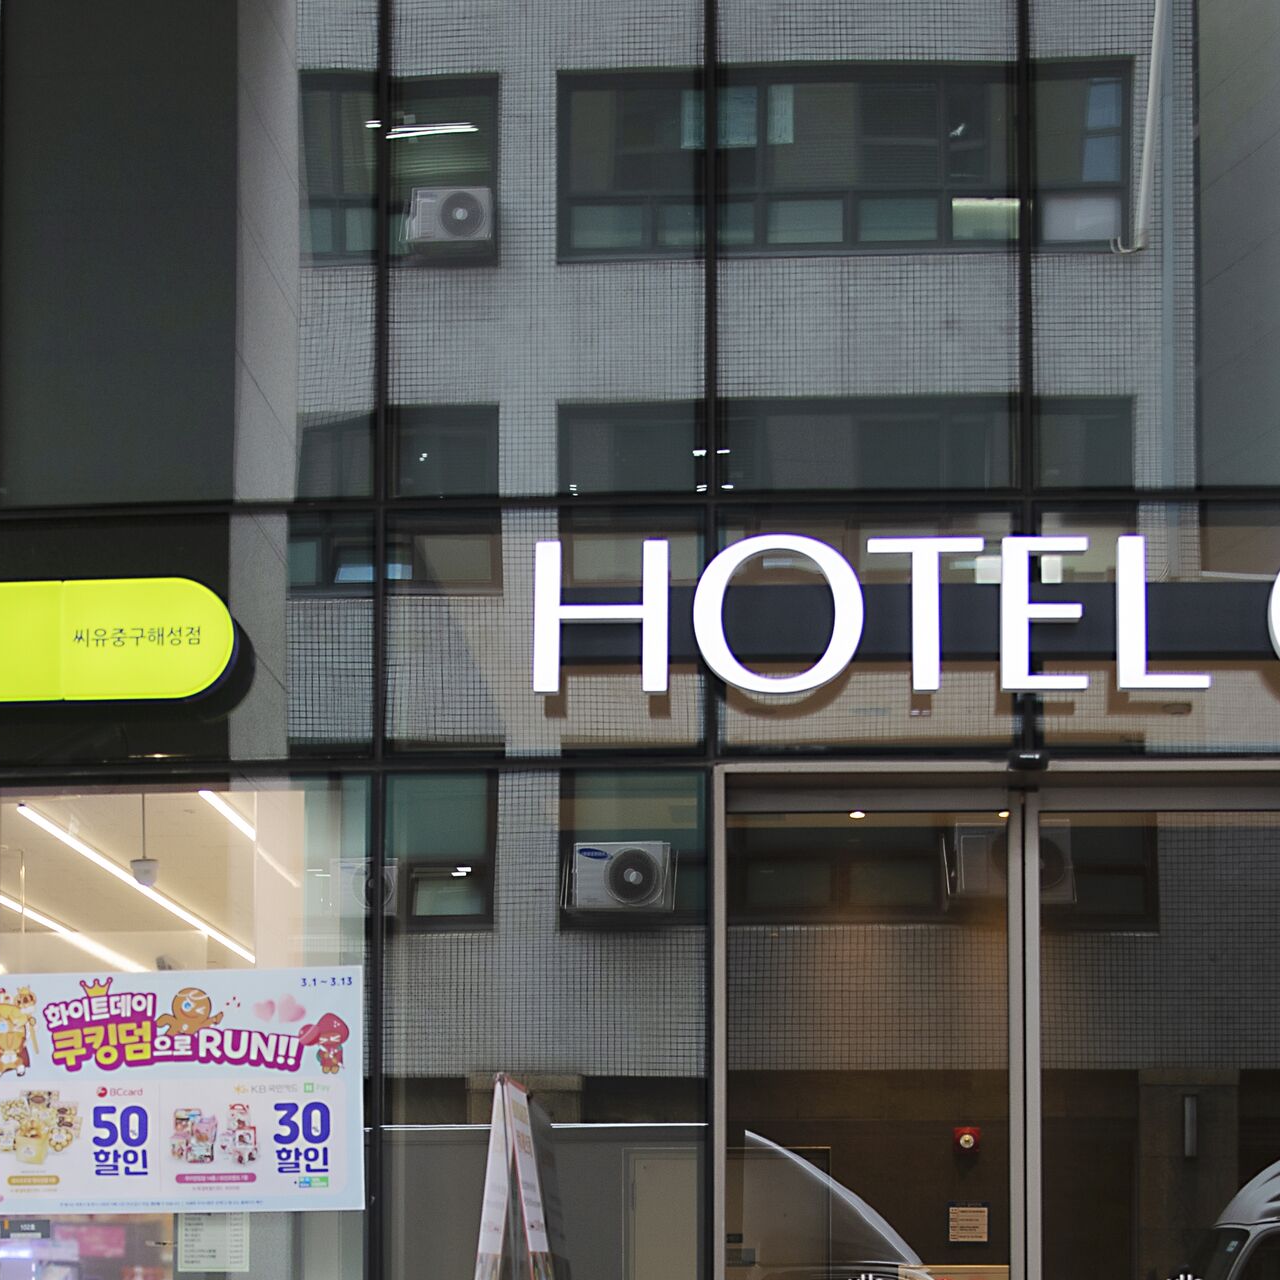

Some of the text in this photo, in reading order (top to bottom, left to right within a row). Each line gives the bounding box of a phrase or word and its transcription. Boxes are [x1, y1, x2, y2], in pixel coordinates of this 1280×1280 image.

[533, 533, 1212, 695] HOTEL
[73, 626, 202, 648] 씨유중구해성점
[300, 977, 318, 988] 3.1
[330, 976, 353, 987] 3.13
[44, 993, 154, 1028] 화이트데이
[51, 1023, 300, 1067] 쿠킹덤으로 RUN!!
[93, 1149, 148, 1176] 할인
[275, 1146, 329, 1174] 할인
